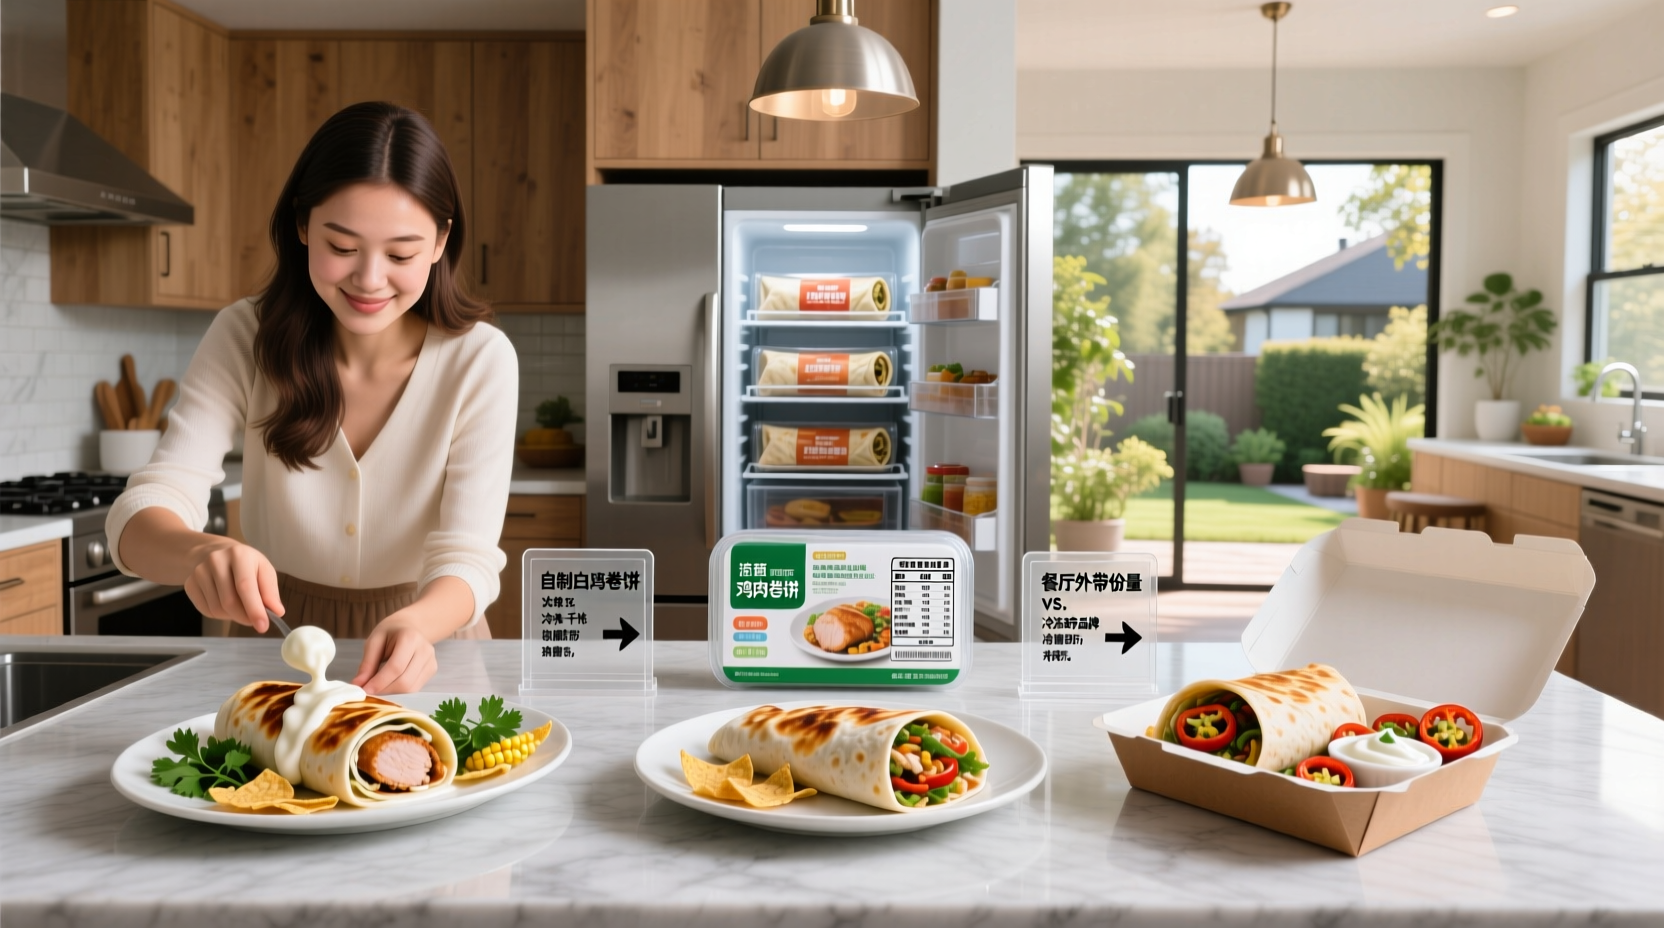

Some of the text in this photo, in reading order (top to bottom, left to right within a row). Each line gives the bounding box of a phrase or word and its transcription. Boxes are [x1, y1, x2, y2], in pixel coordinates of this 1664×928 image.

[1041, 572, 1142, 592] 餐厅外带份量
[1041, 597, 1067, 611] VS.
